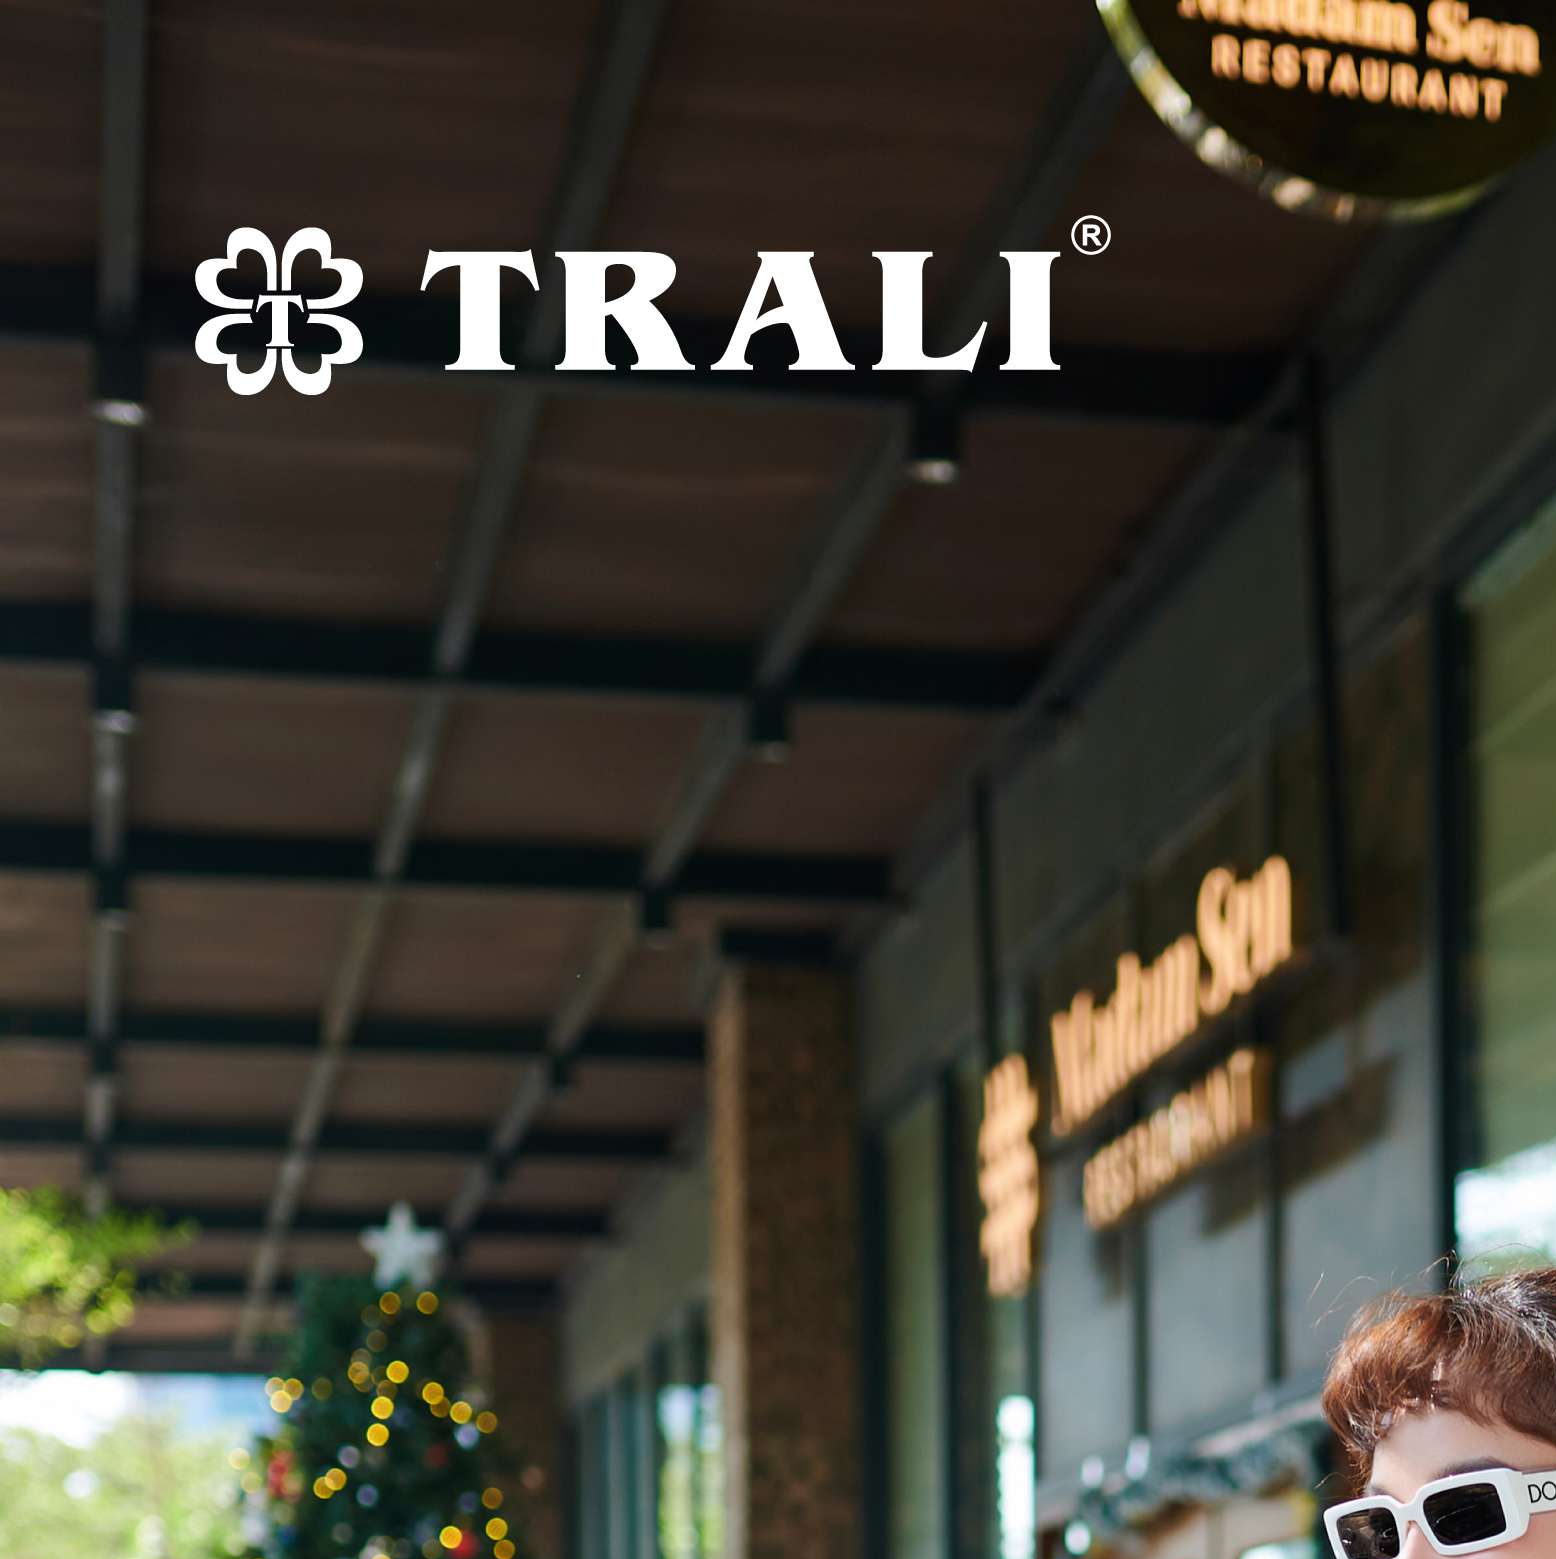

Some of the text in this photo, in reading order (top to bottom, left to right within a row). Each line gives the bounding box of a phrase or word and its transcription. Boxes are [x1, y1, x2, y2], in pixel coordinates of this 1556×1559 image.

[1211, 34, 1508, 122] RESTAURANT
[1426, 0, 1541, 77] Sen
[1198, 855, 1293, 1015] Sen
